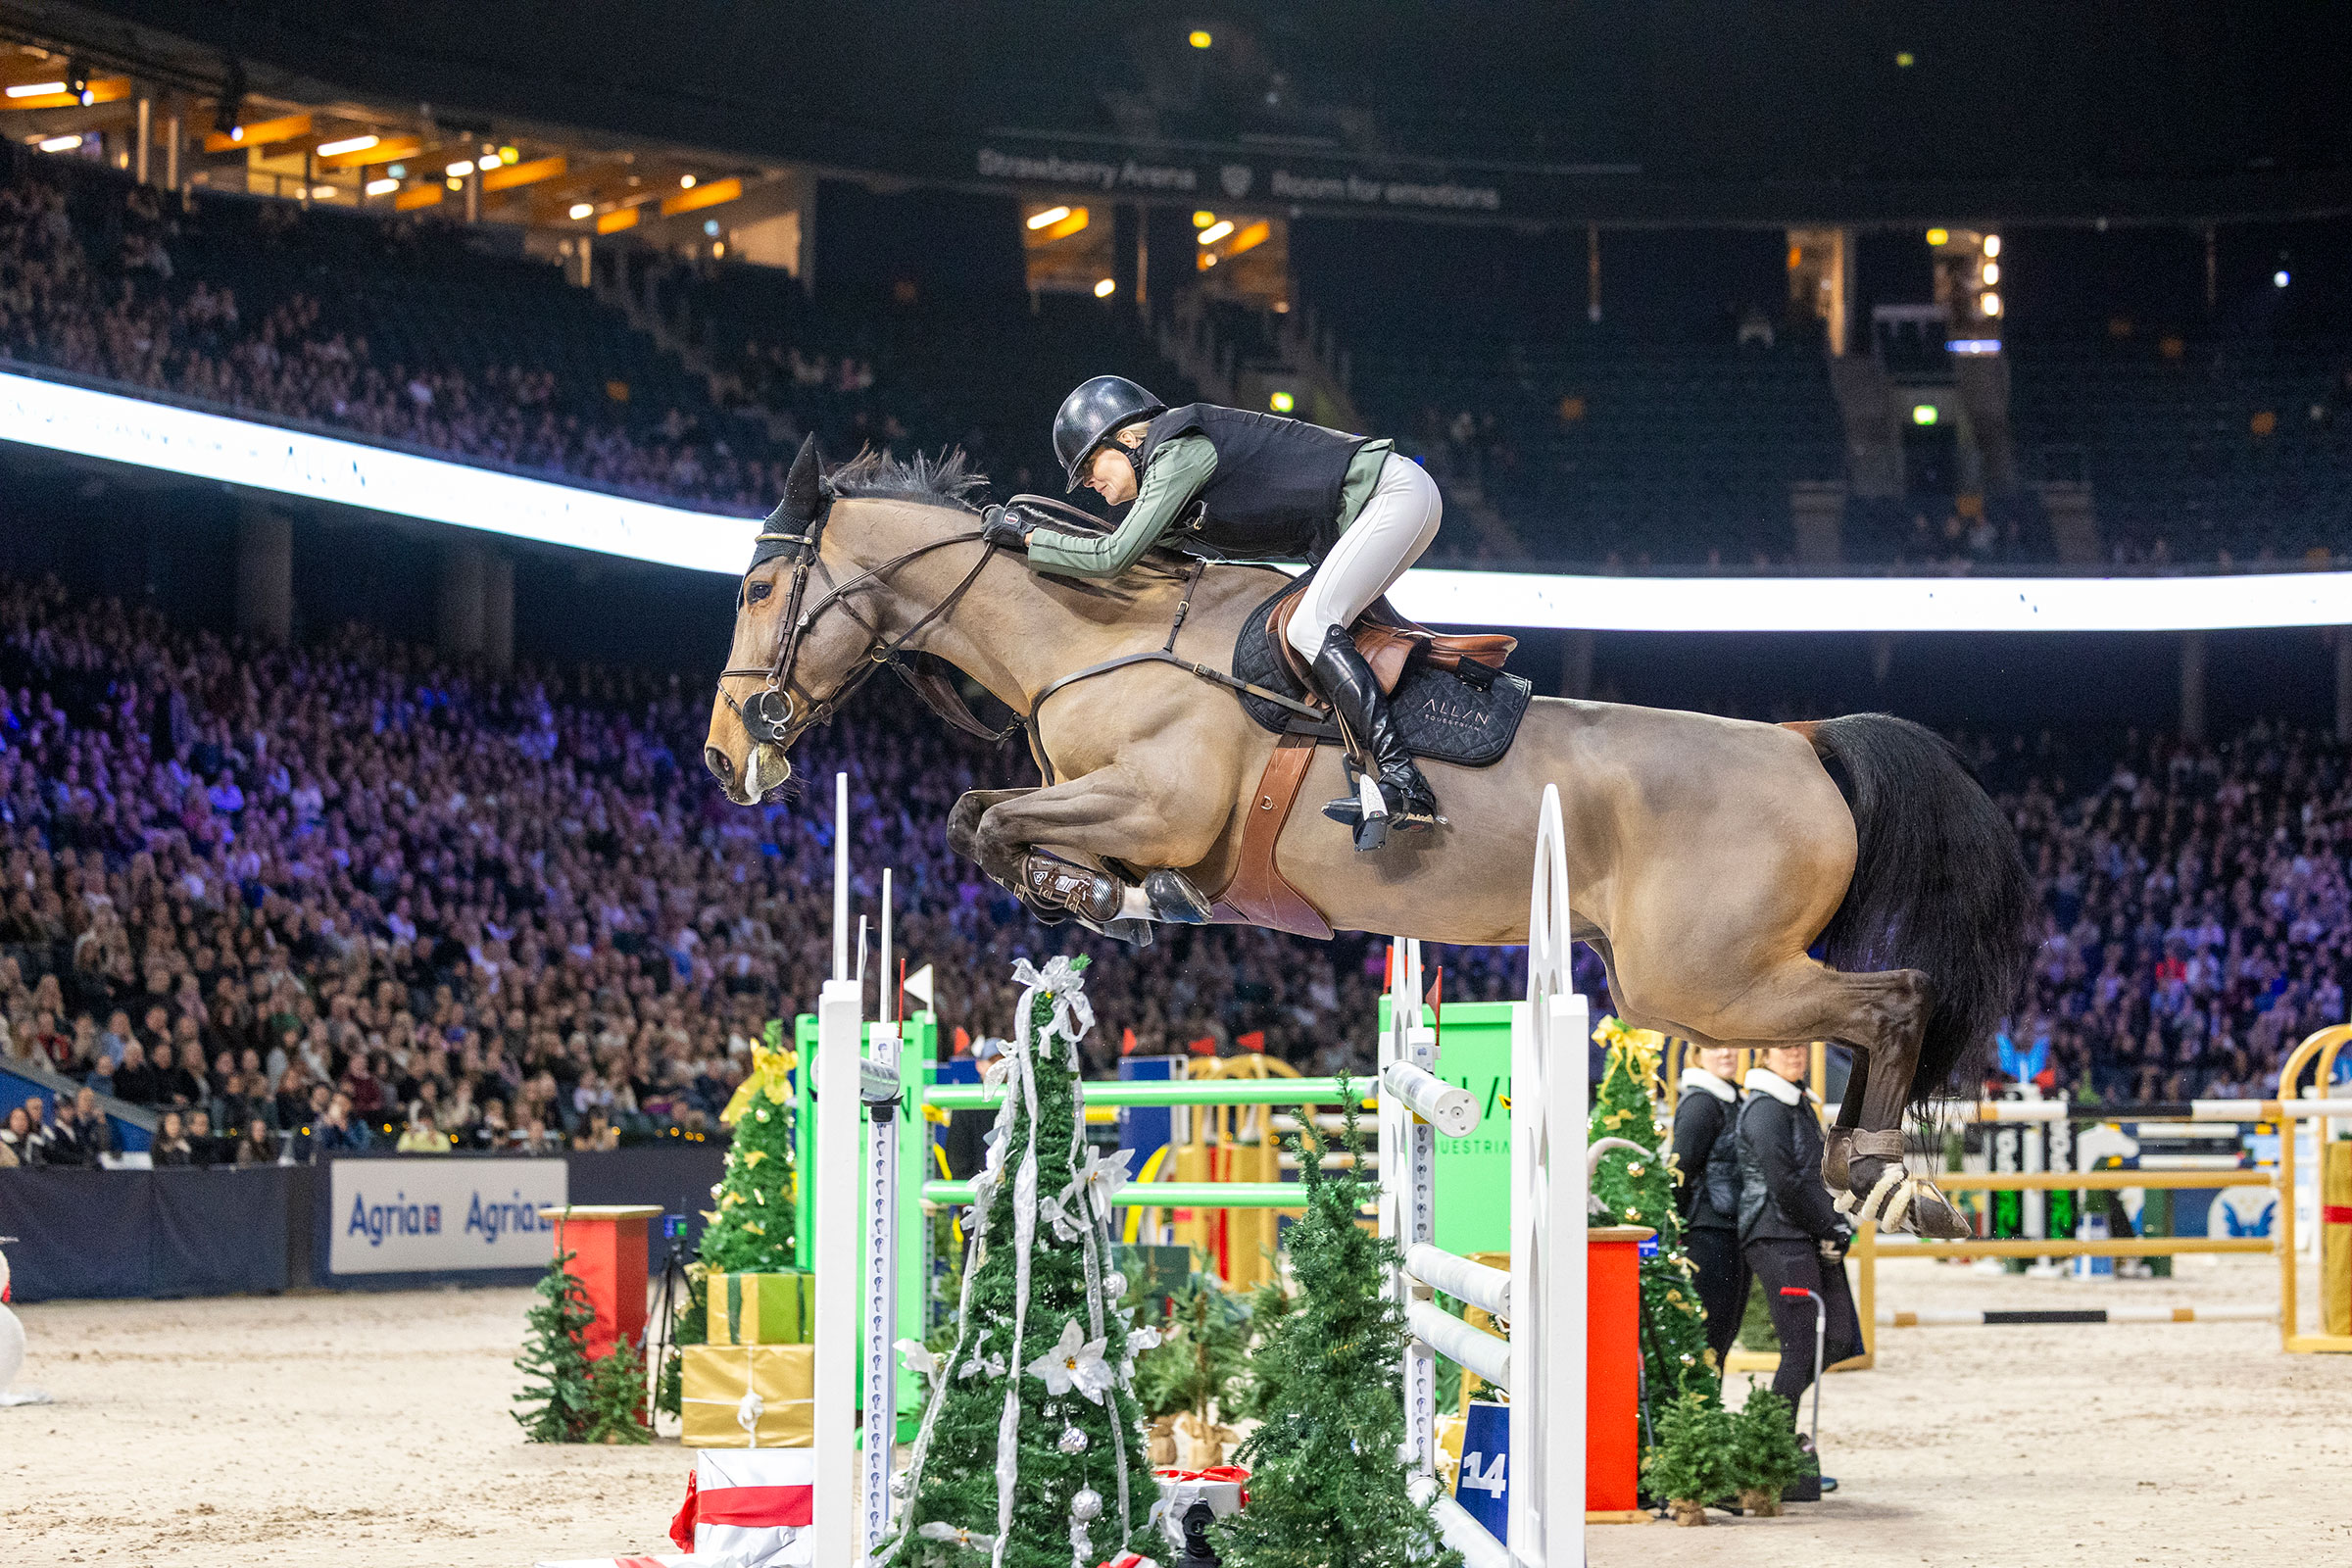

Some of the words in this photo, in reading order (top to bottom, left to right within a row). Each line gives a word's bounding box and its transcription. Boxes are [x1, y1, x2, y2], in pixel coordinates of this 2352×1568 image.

[977, 148, 1116, 188] Strawberry
[1120, 161, 1198, 189] Arena
[1271, 169, 1345, 198] Room
[1348, 175, 1381, 201] for
[1384, 184, 1500, 210] emotions
[1424, 713, 1481, 732] EQUESTRIAN
[1435, 1140, 1511, 1155] UESTRIA
[347, 1191, 421, 1248] Agria
[465, 1189, 536, 1245] Agria
[1461, 1451, 1507, 1499] 14
